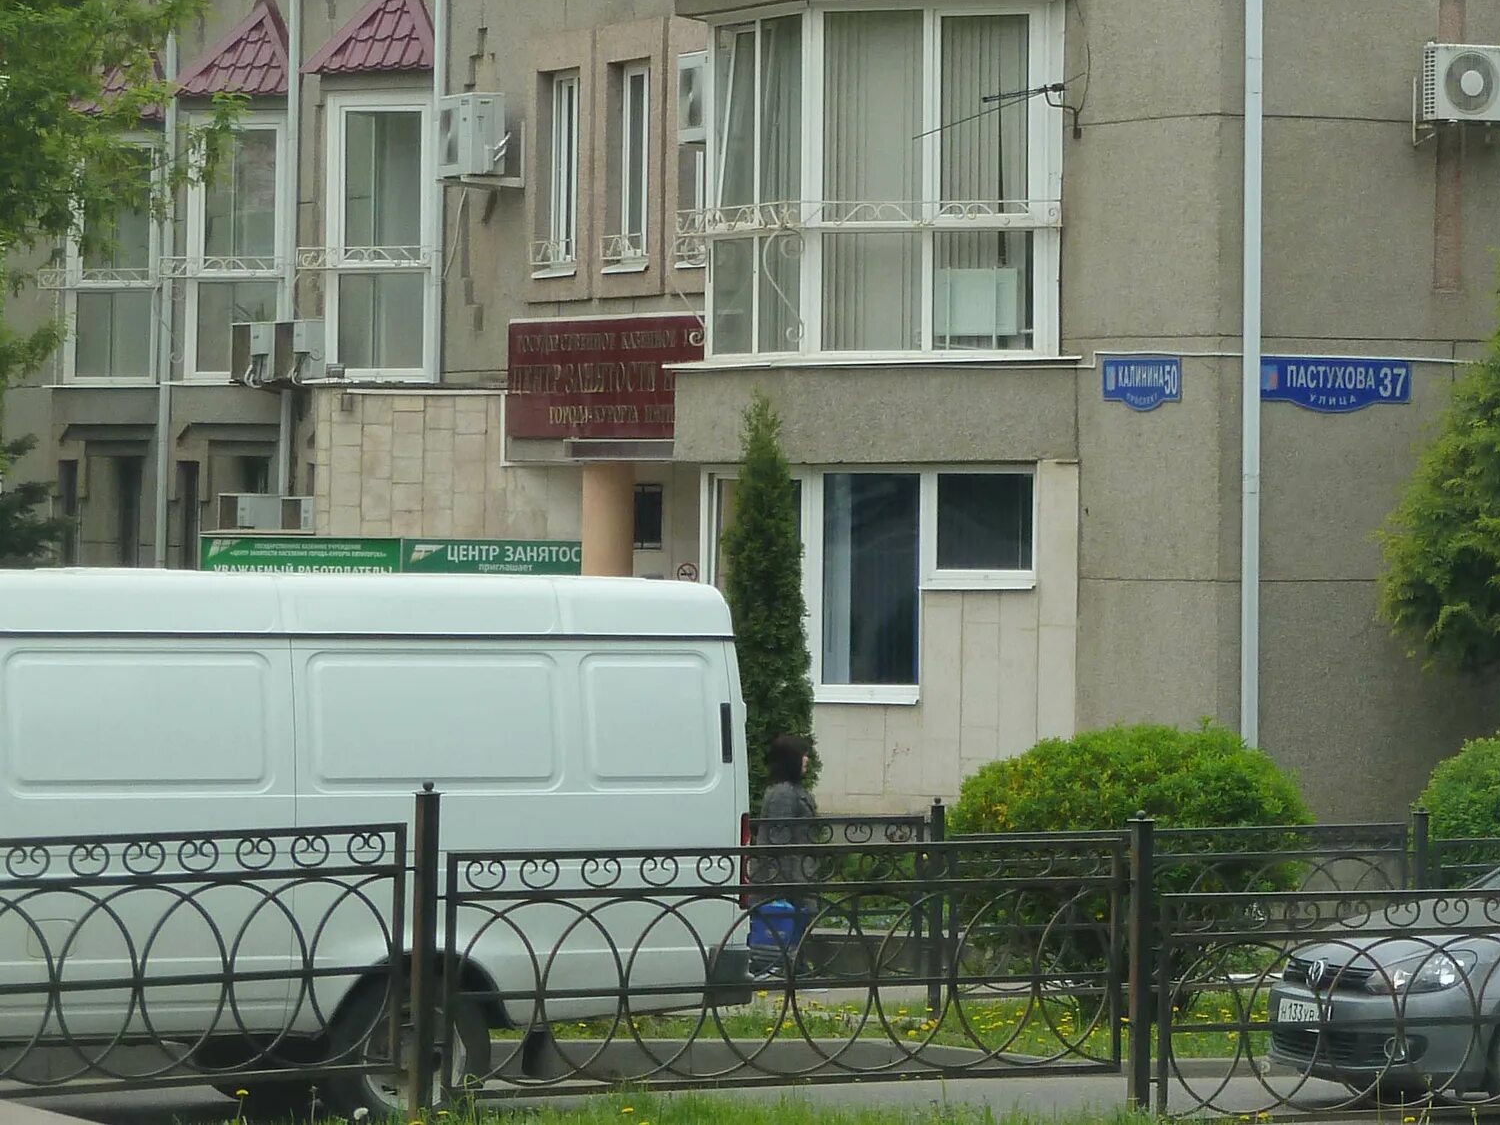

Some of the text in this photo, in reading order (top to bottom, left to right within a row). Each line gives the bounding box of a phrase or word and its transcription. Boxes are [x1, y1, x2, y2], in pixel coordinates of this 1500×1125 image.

[511, 364, 561, 394] ЦЕНТР
[1118, 364, 1178, 395] КАЛИНИНА 50
[1286, 364, 1407, 397] ПАСТУХОВА 37
[1310, 393, 1357, 406] УЛИЦА
[447, 544, 581, 563] ЦЕНТР ЗАНЯТОС
[478, 563, 534, 572] приглашает
